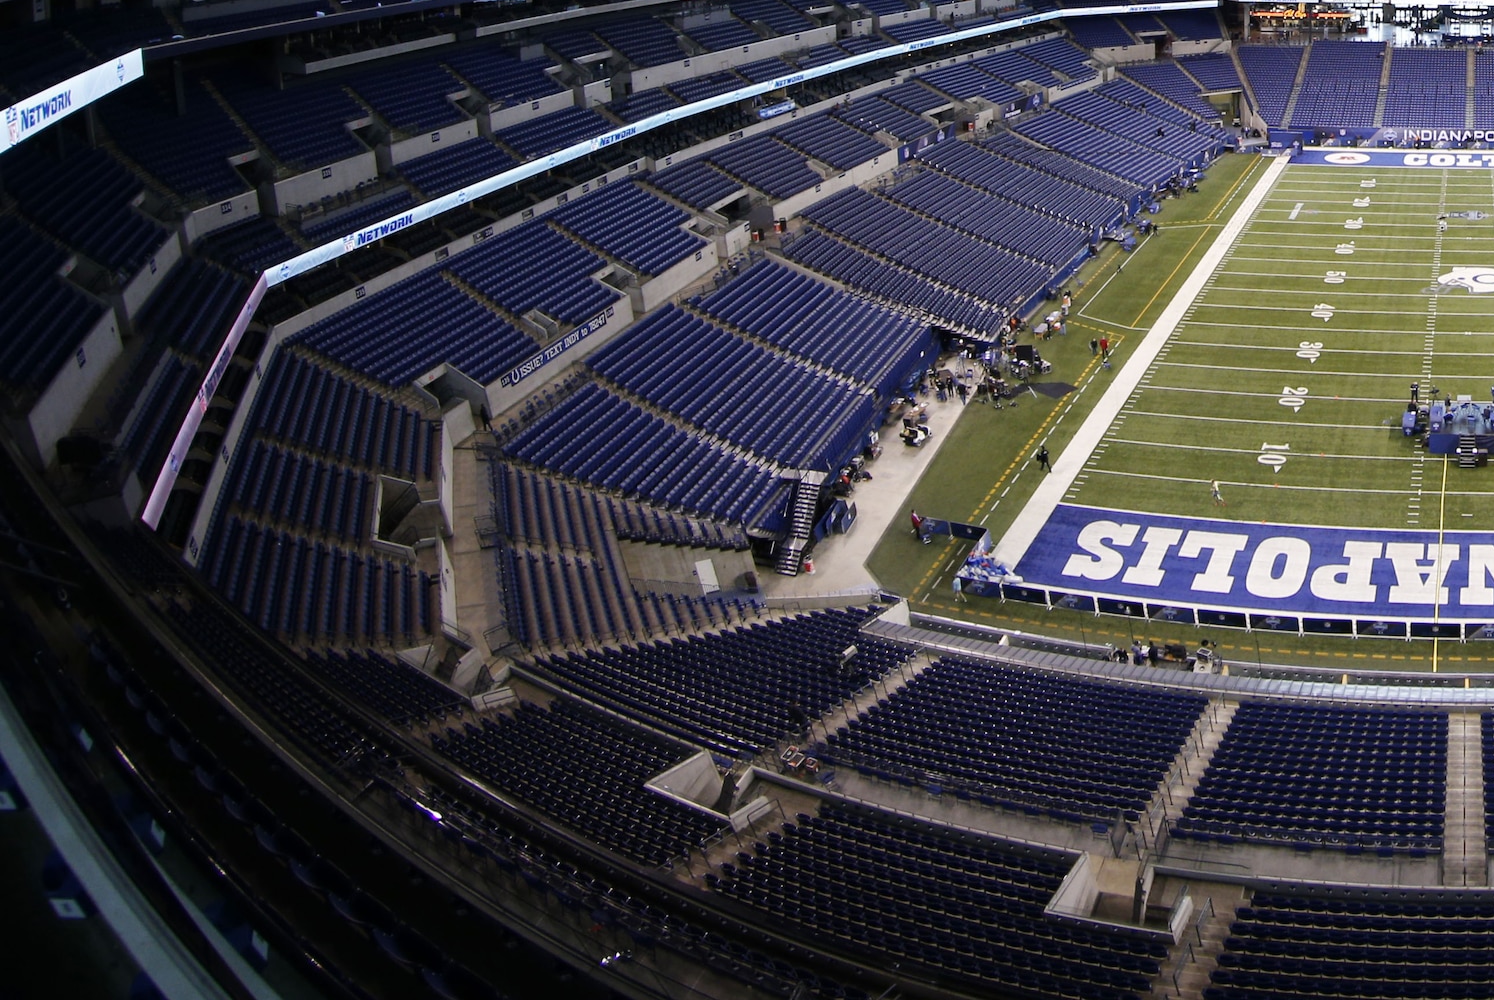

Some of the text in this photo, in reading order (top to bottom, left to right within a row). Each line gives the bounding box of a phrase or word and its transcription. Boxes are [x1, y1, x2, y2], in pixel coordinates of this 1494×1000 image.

[774, 74, 804, 88] NETWORK
[21, 89, 72, 132] NETWORK
[599, 126, 637, 146] NETWORK
[356, 213, 414, 247] NETWORK
[1323, 271, 1347, 284] 50
[1311, 303, 1336, 318] 40
[520, 355, 544, 378] ISSUE?
[545, 342, 563, 360] TEXT
[564, 331, 580, 348] INDY
[581, 327, 588, 337] to
[1296, 341, 1324, 359] 30
[204, 344, 232, 398] NETWORK
[1278, 386, 1309, 408] 20
[1257, 442, 1290, 467] 10
